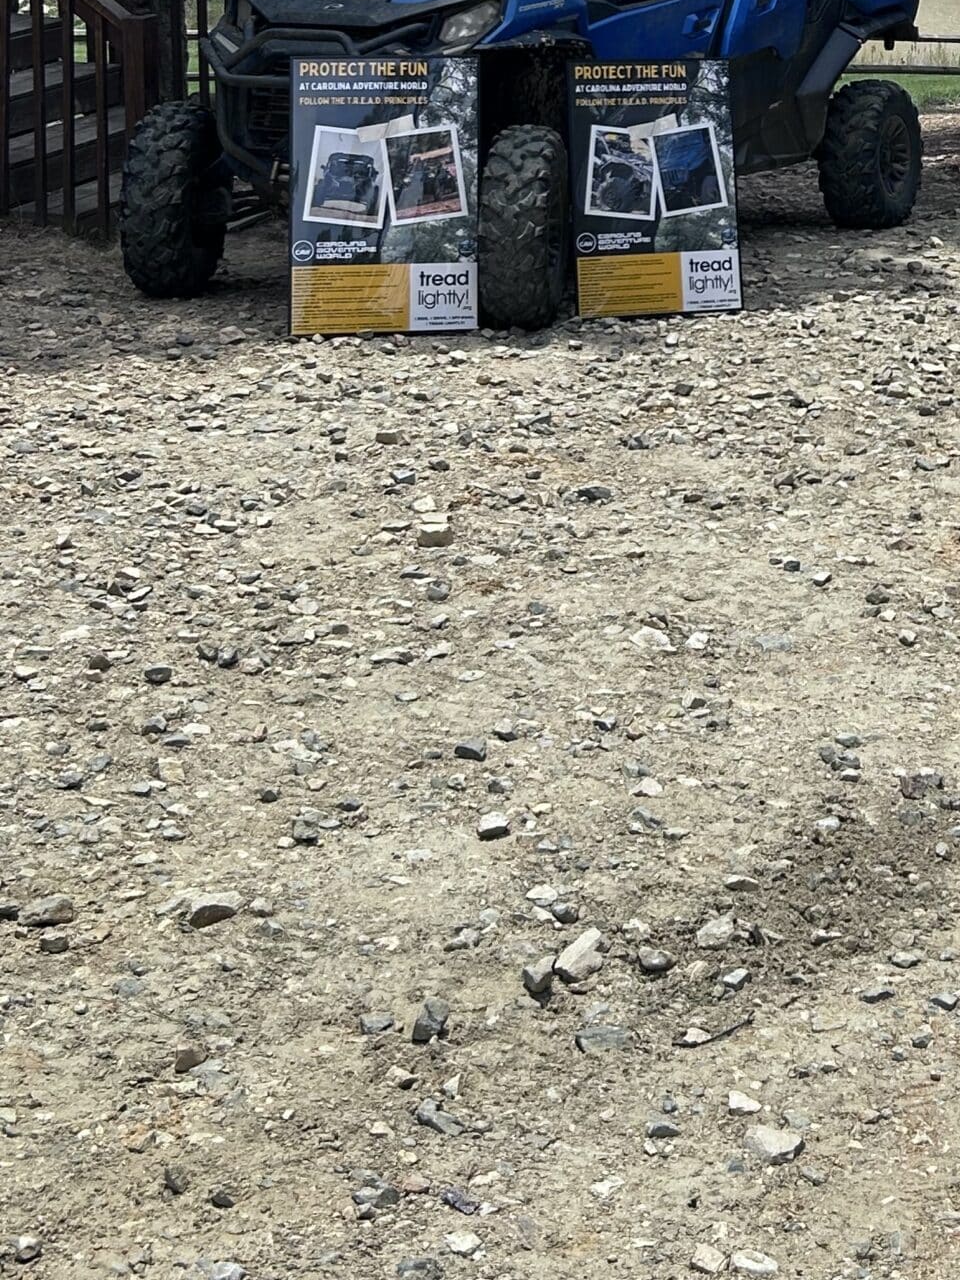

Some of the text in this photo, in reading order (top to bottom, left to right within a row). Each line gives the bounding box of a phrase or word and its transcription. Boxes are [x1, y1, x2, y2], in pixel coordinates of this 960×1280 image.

[299, 62, 428, 77] PROTECT THE FUN
[574, 65, 687, 79] PROTECT THE FUN
[299, 81, 428, 91] AT CAROLINA ADVENTURE WORLD
[575, 82, 687, 93] AT CAROLINA ADVENTURE WORLD
[299, 97, 330, 106] FOLLOW
[330, 97, 346, 105] THE
[384, 96, 429, 105] PRINCIPLES
[689, 256, 733, 272] tread
[419, 270, 469, 286] tread
[688, 273, 733, 293] lightly!
[418, 289, 469, 309] lightly!
